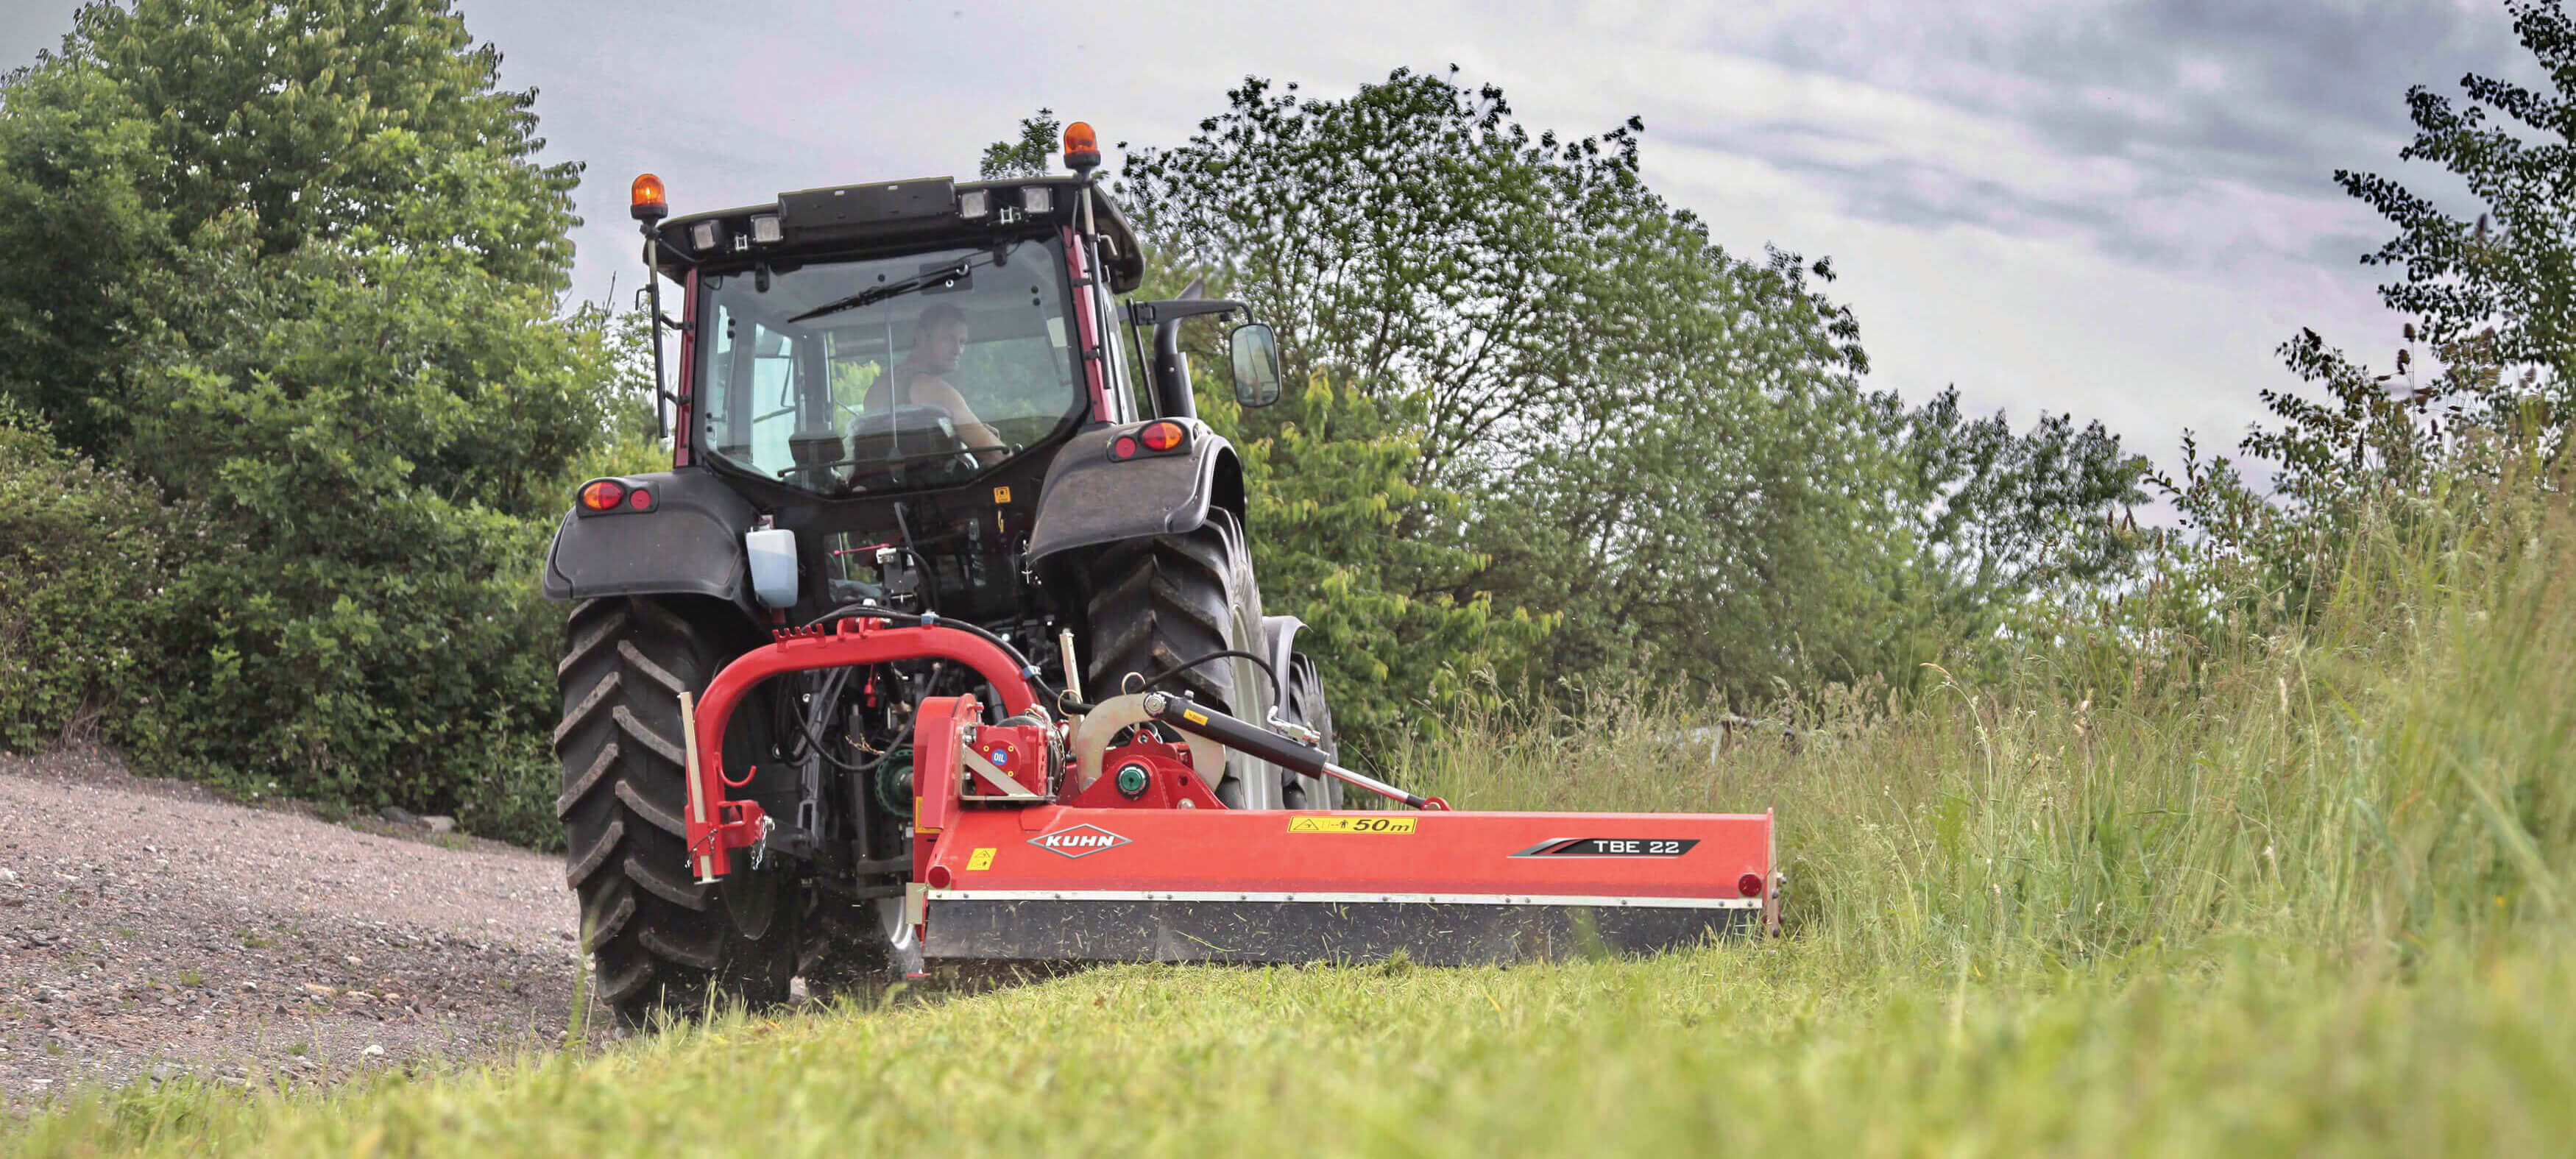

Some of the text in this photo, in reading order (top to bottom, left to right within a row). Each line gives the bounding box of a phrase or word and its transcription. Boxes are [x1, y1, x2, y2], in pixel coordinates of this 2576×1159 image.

[994, 753, 1005, 762] OIL
[1045, 835, 1114, 846] KUHN
[1593, 840, 1680, 854] TBE 22
